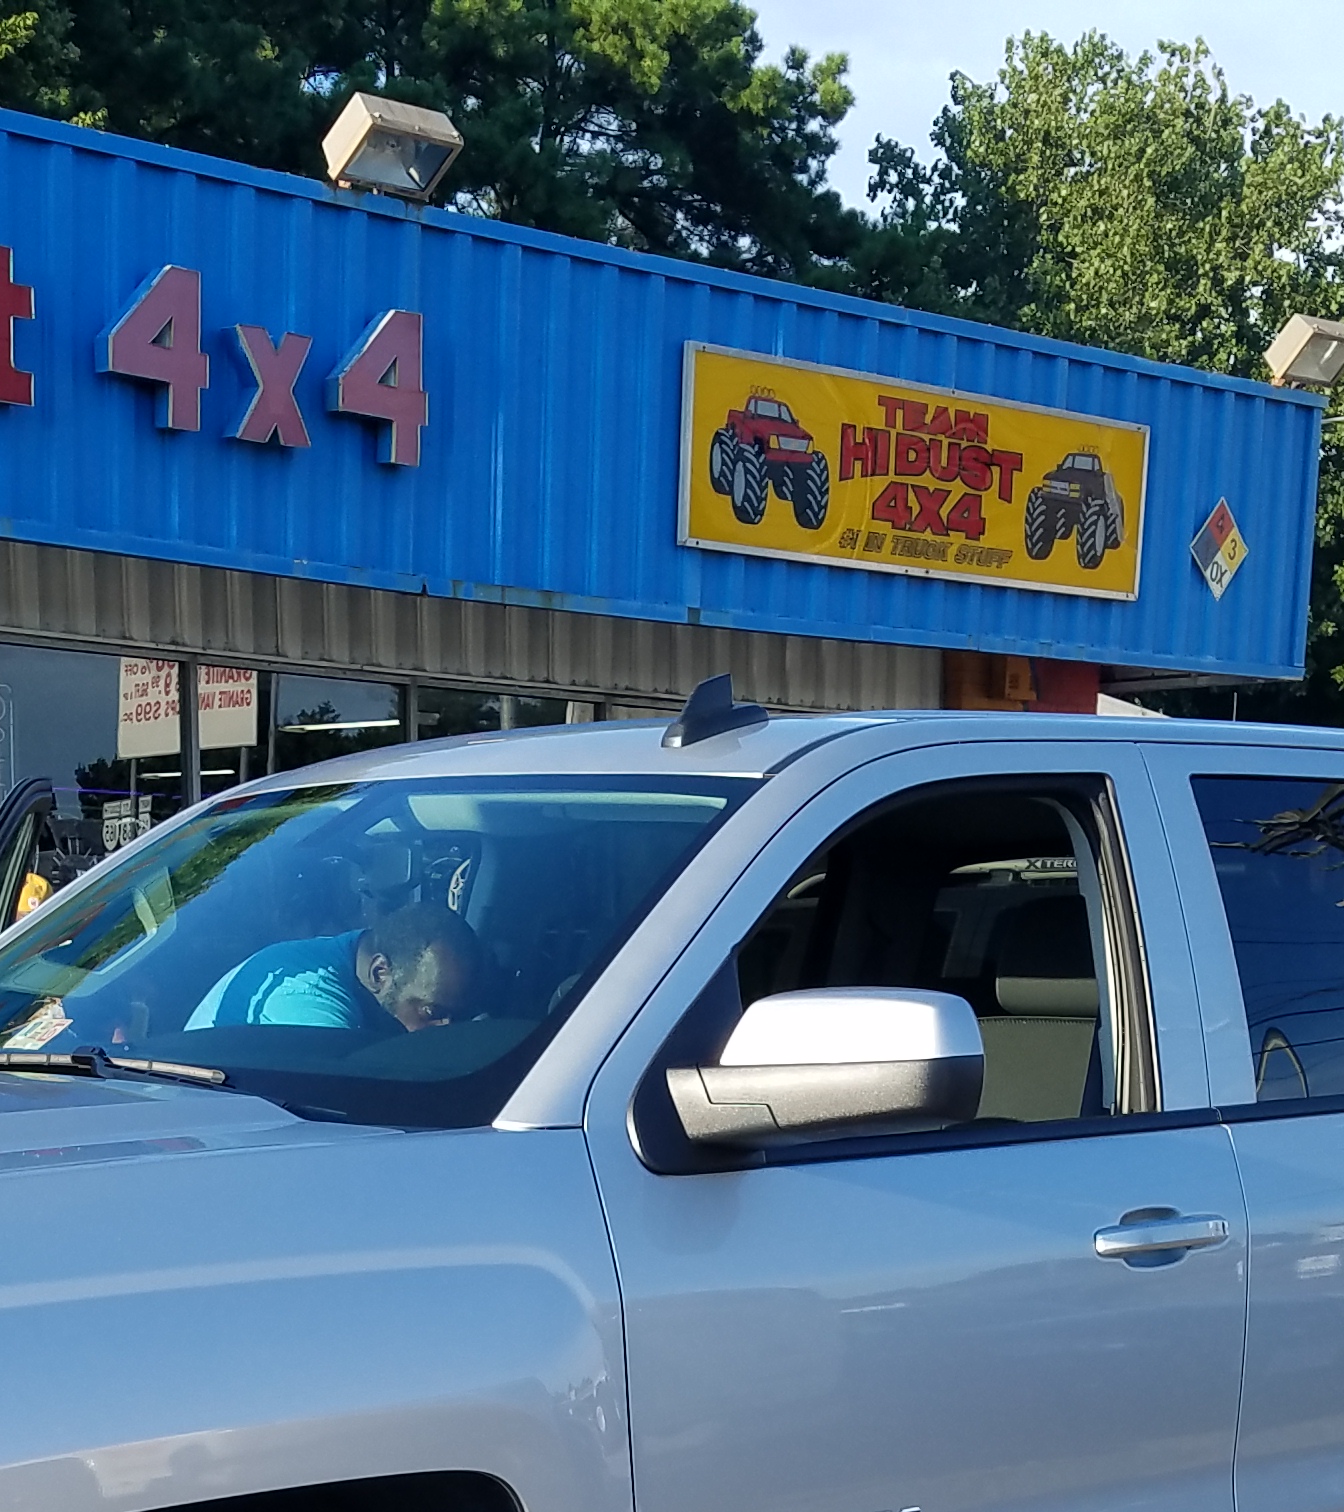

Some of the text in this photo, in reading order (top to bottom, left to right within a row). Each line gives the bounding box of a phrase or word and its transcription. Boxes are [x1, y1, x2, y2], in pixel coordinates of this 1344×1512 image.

[94, 262, 430, 468] 4x4
[878, 395, 989, 444] TEAM
[839, 423, 1023, 504] HI DUST
[872, 481, 986, 541] 4X4
[863, 531, 887, 553] IN
[890, 535, 953, 562] TRUCK
[954, 544, 1014, 569] STUFF
[1227, 538, 1237, 561] 3
